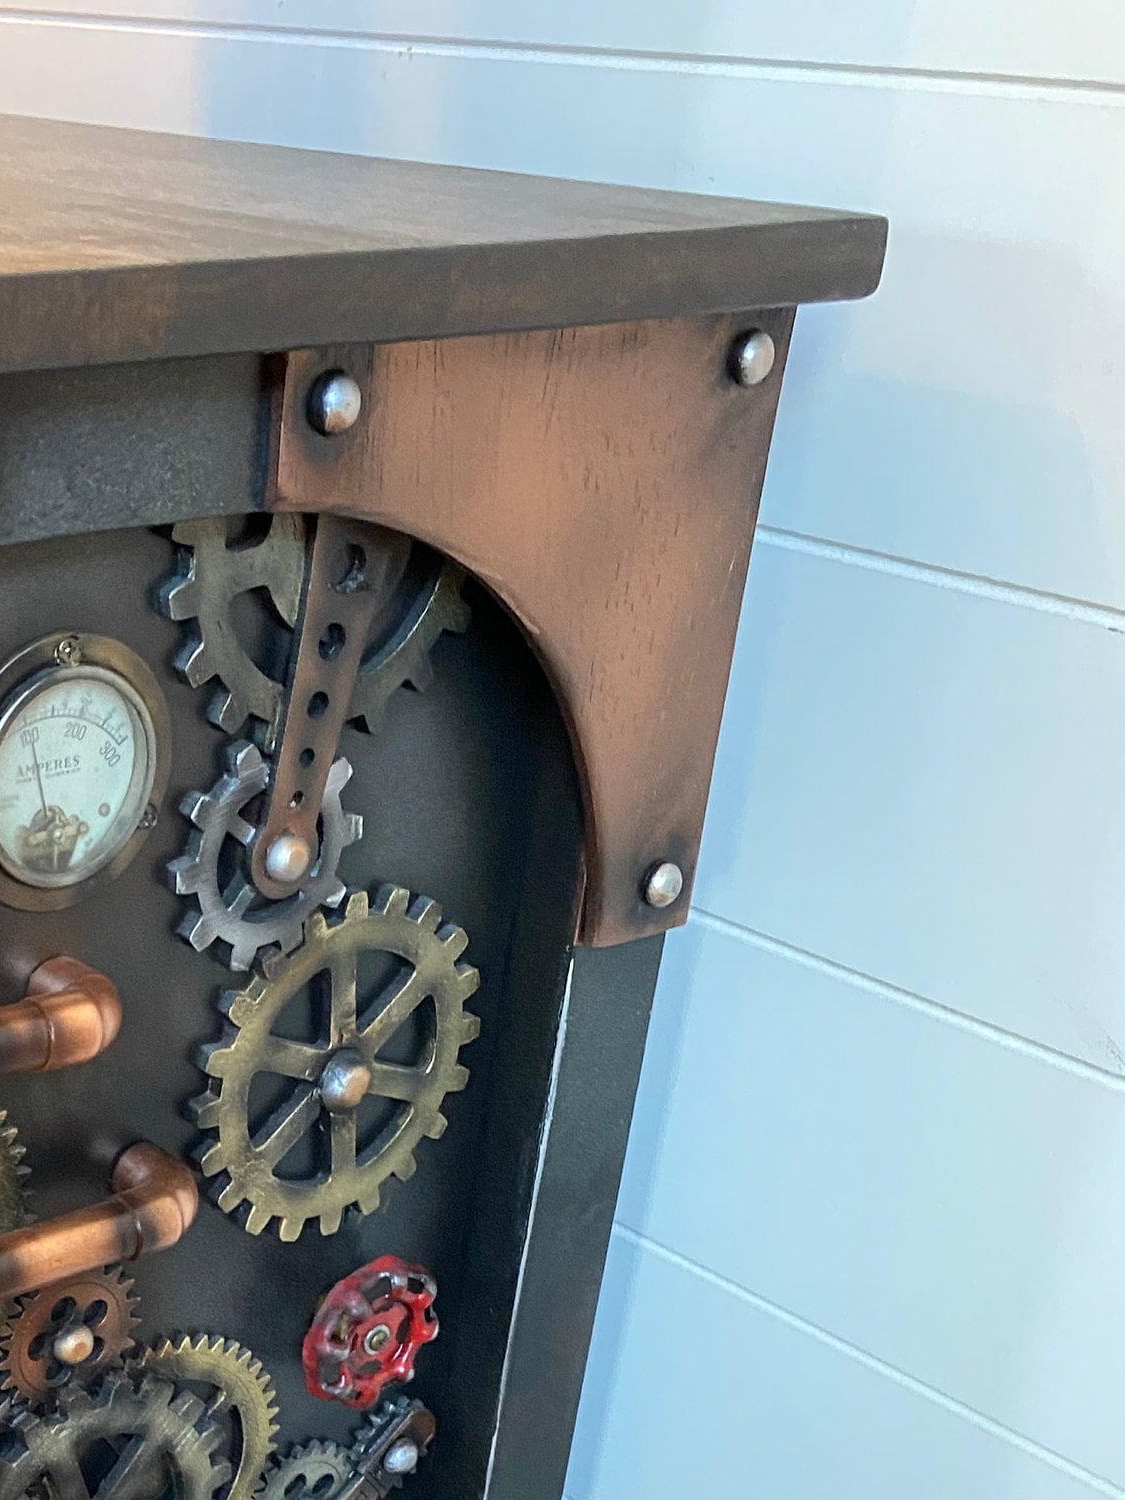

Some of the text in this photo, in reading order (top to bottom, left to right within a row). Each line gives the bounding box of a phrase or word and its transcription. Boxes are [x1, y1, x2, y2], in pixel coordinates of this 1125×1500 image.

[20, 727, 40, 748] 100
[63, 720, 87, 741] 200
[99, 741, 121, 767] 300
[16, 755, 81, 777] AMPERES
